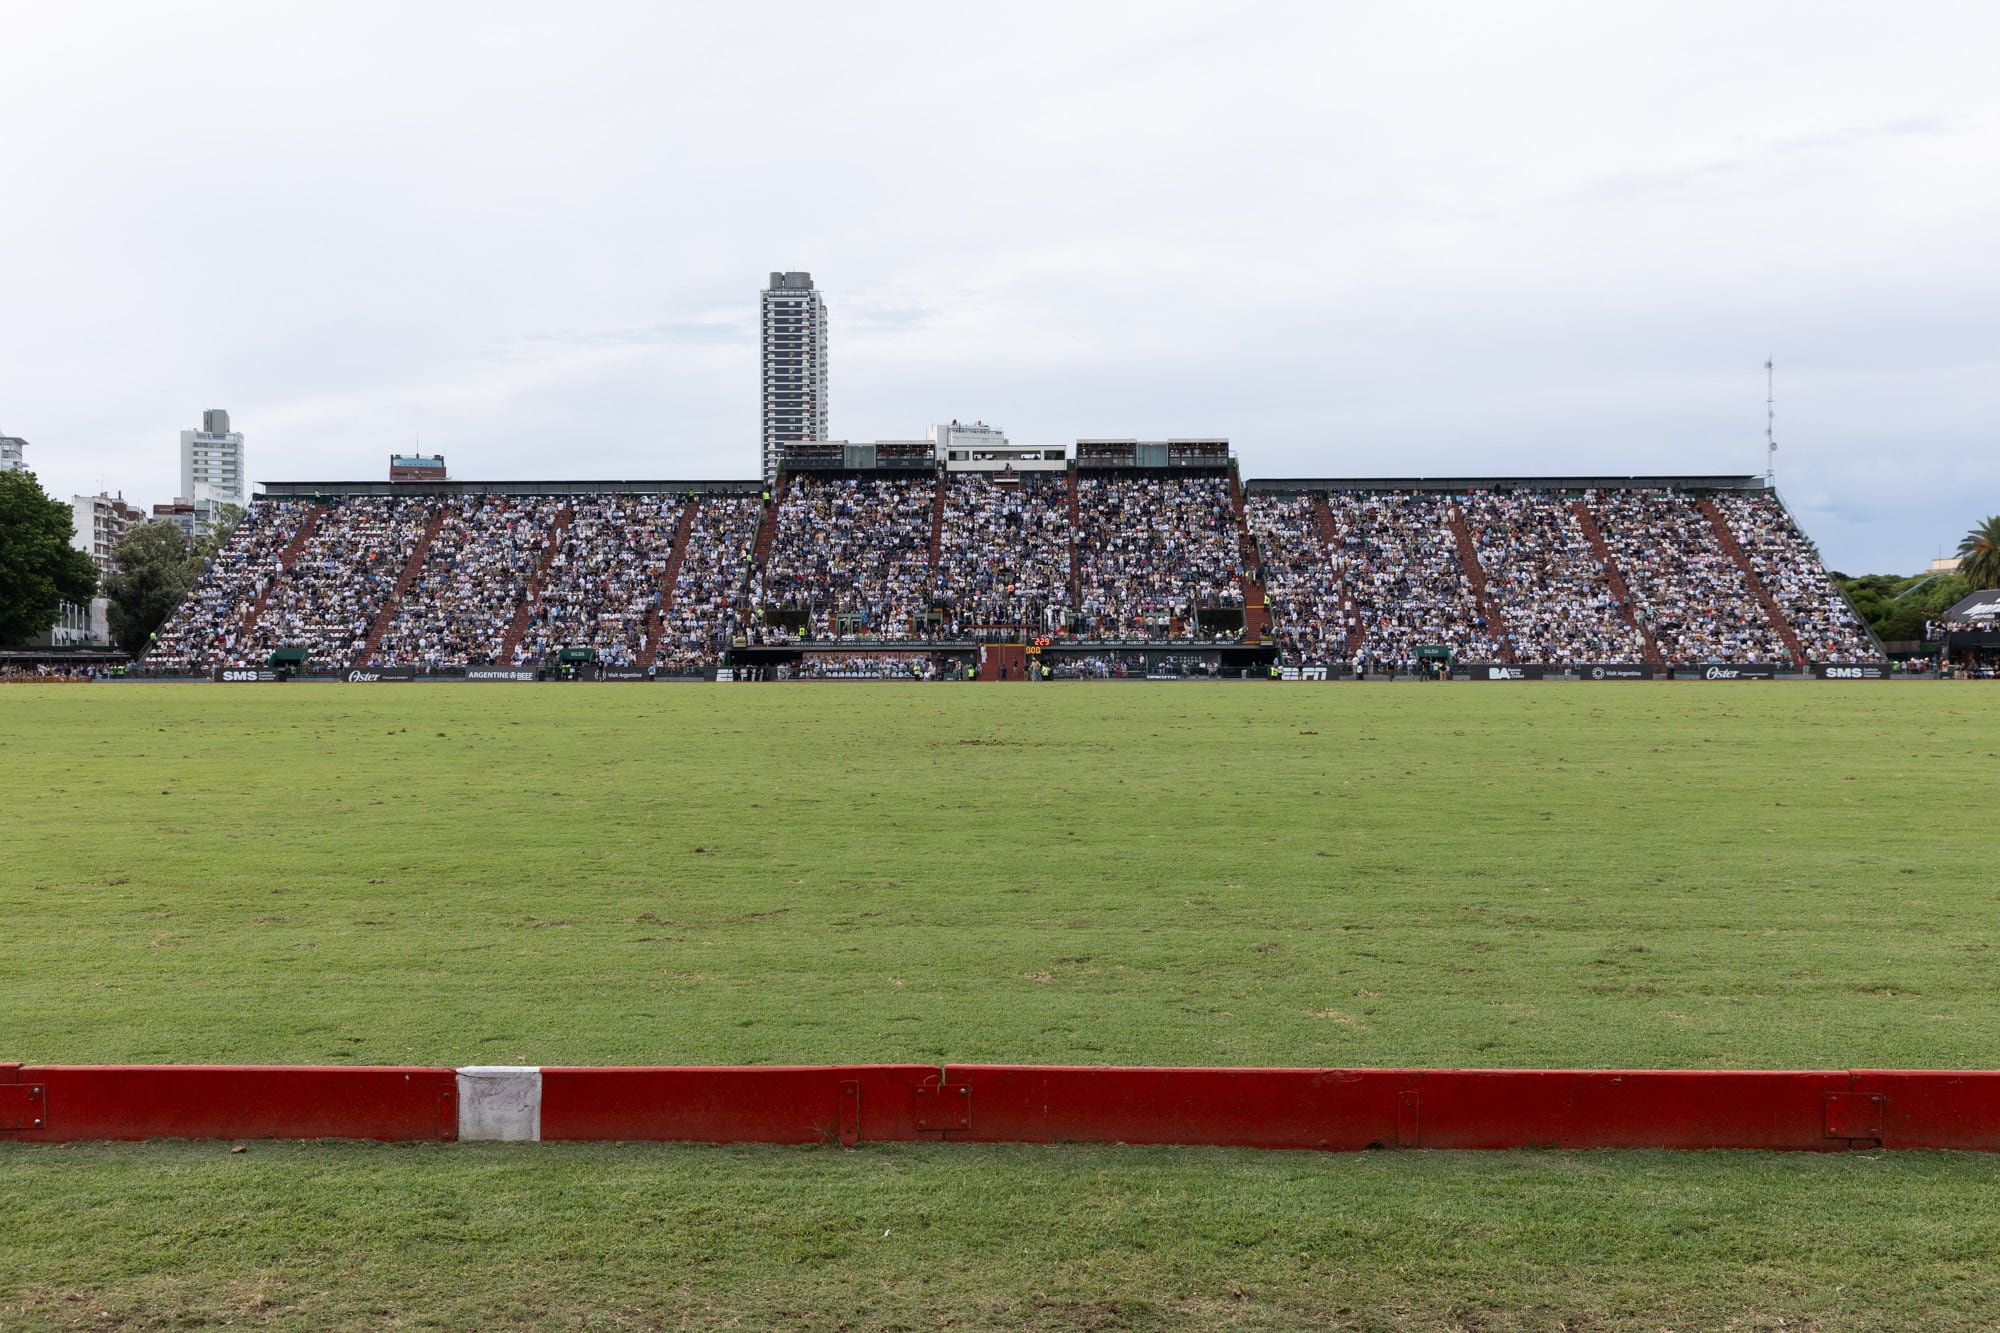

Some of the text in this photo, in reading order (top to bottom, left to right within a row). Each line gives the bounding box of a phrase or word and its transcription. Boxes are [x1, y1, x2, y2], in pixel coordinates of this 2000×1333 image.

[223, 671, 258, 680] SMS
[348, 670, 380, 682] Oster
[517, 672, 533, 680] BEEF
[1282, 668, 1328, 680] ESPN
[1489, 668, 1510, 680] BA
[1706, 666, 1740, 680] Oster
[1826, 668, 1862, 678] SMS
